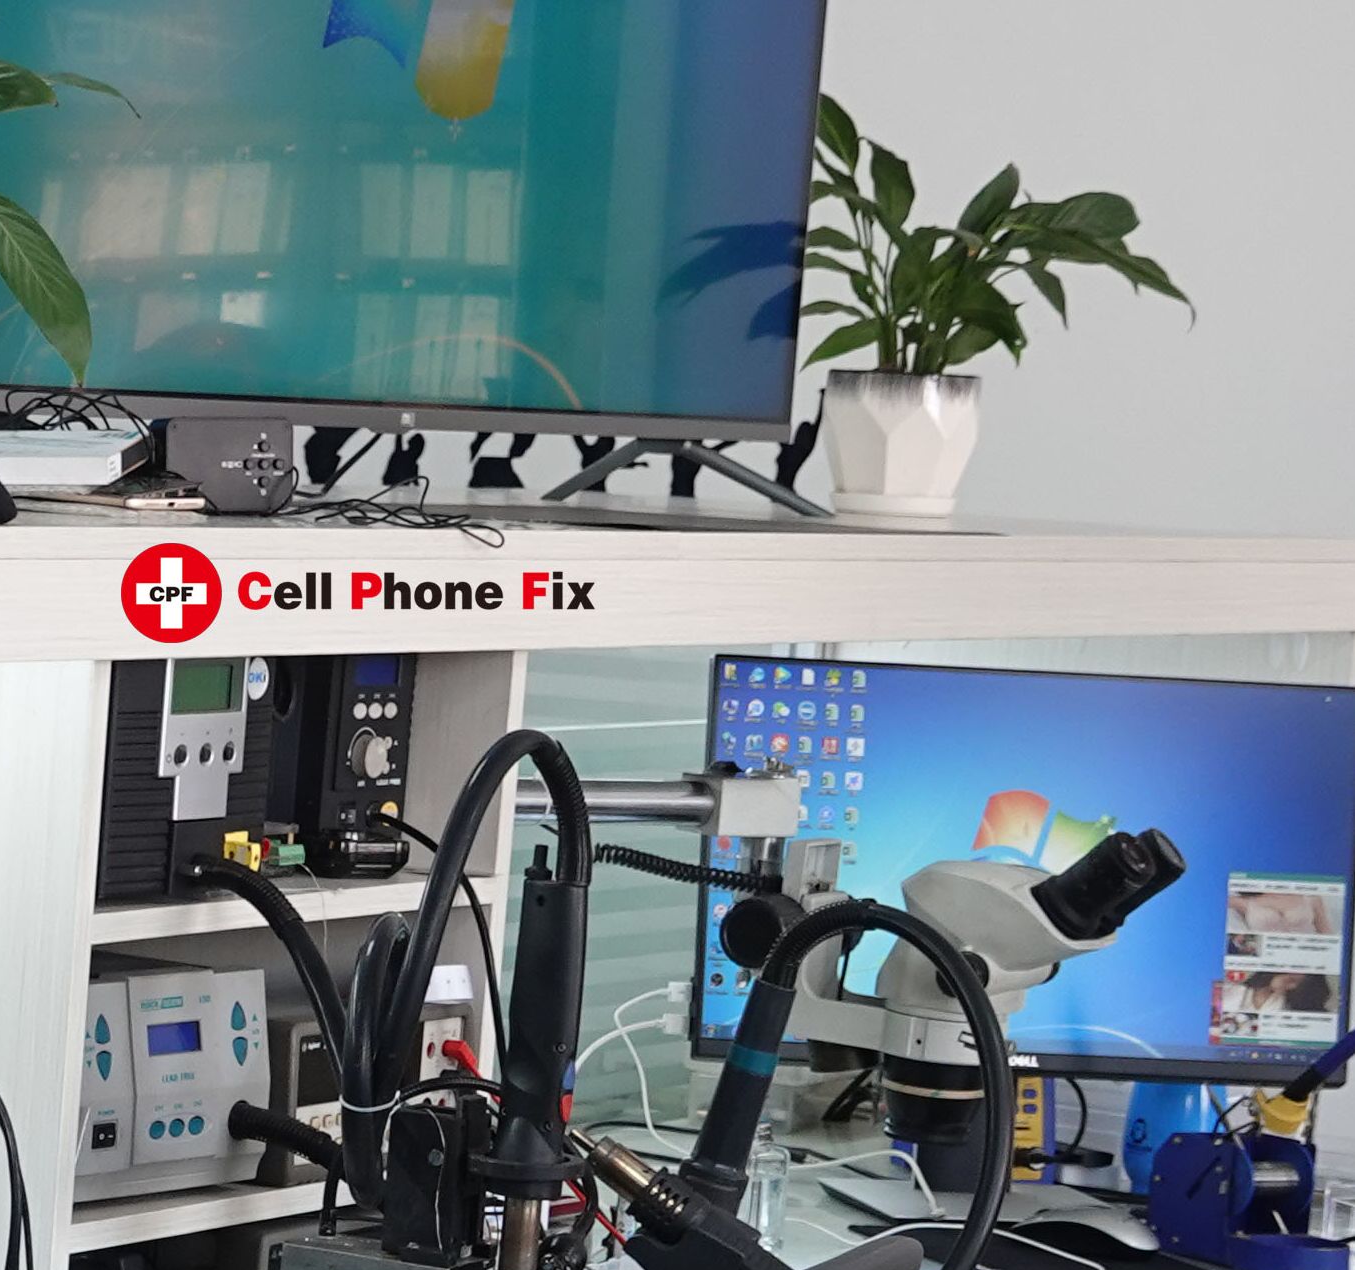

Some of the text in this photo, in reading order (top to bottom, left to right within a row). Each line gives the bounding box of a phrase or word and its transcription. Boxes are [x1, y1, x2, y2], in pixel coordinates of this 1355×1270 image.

[149, 586, 193, 602] CPF
[237, 571, 596, 611] Cell Phone Fix
